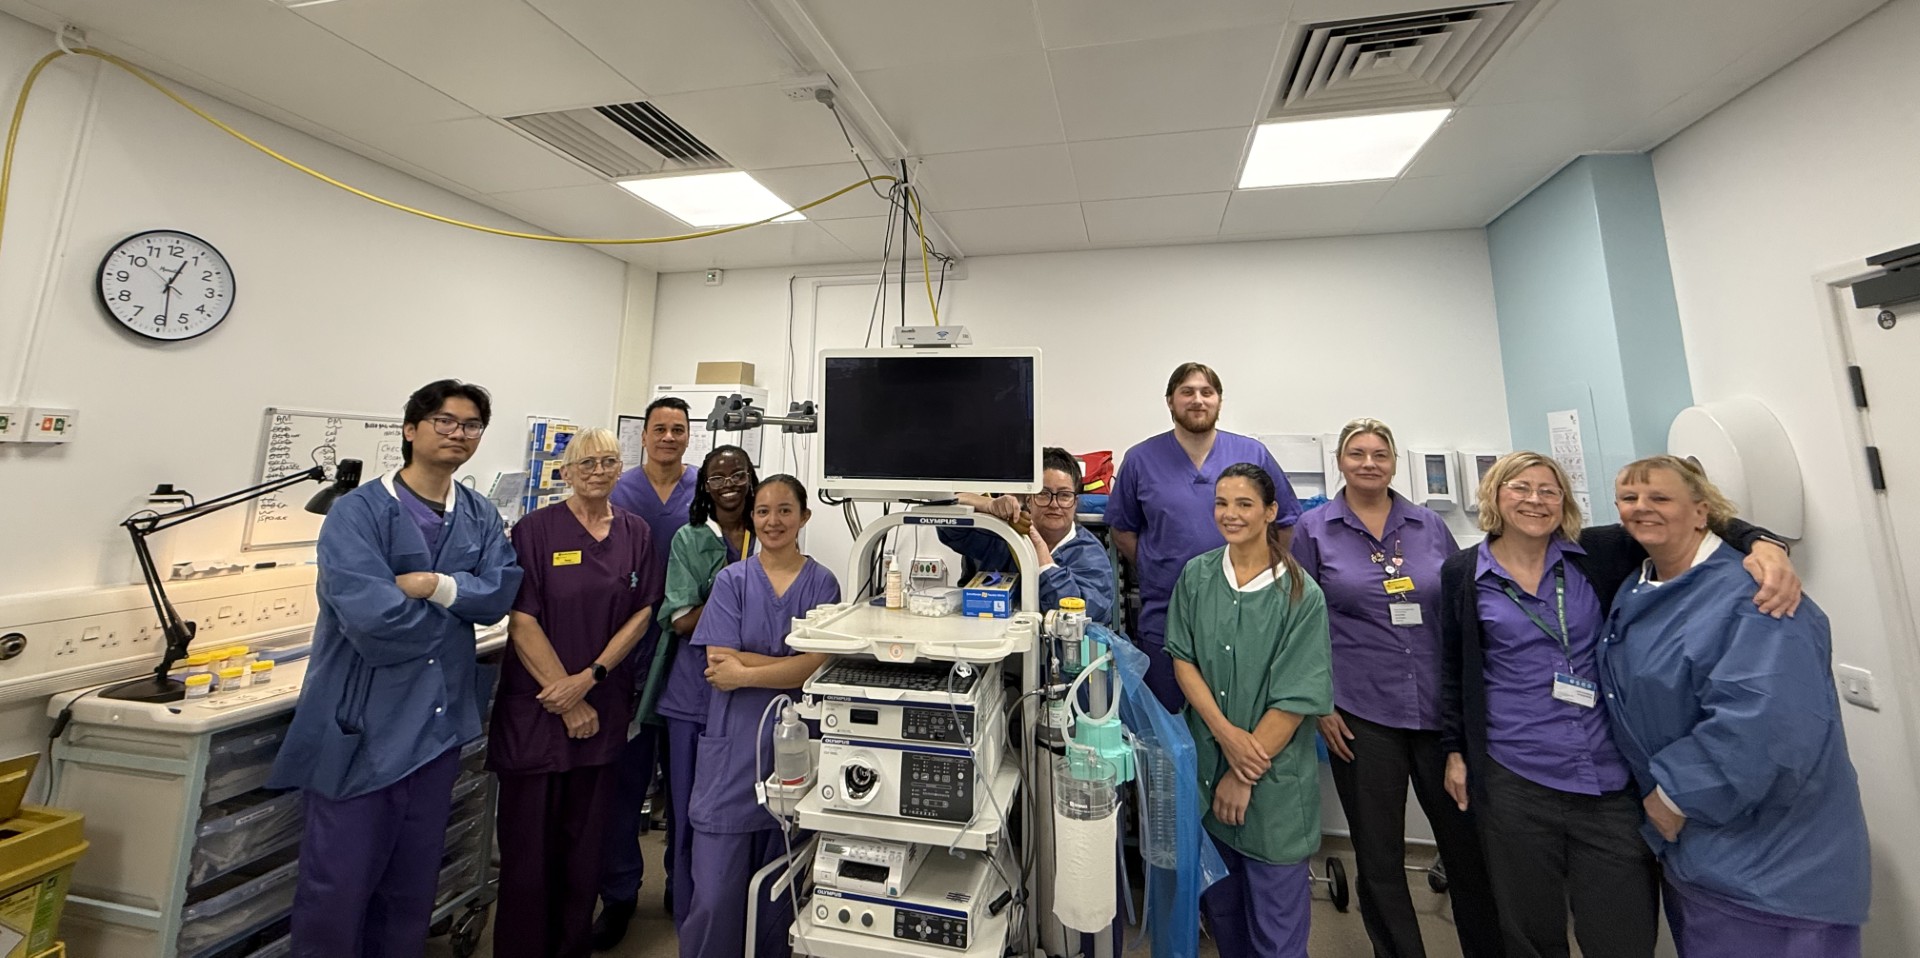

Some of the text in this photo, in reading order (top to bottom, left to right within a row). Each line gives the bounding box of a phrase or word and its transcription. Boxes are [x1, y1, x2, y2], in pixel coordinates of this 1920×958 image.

[146, 246, 161, 258] 11
[167, 245, 185, 258] 12
[127, 254, 148, 268] 10
[192, 256, 199, 266] 1
[116, 270, 130, 282] 9
[201, 270, 213, 282] 2
[118, 289, 132, 302] 8
[204, 287, 215, 299] 3
[133, 305, 144, 317] 7
[195, 304, 206, 315] 4
[153, 314, 166, 326] 6
[177, 313, 189, 324] 5
[919, 517, 958, 525] OLYMPUS
[816, 889, 842, 898] OLYMPUS
